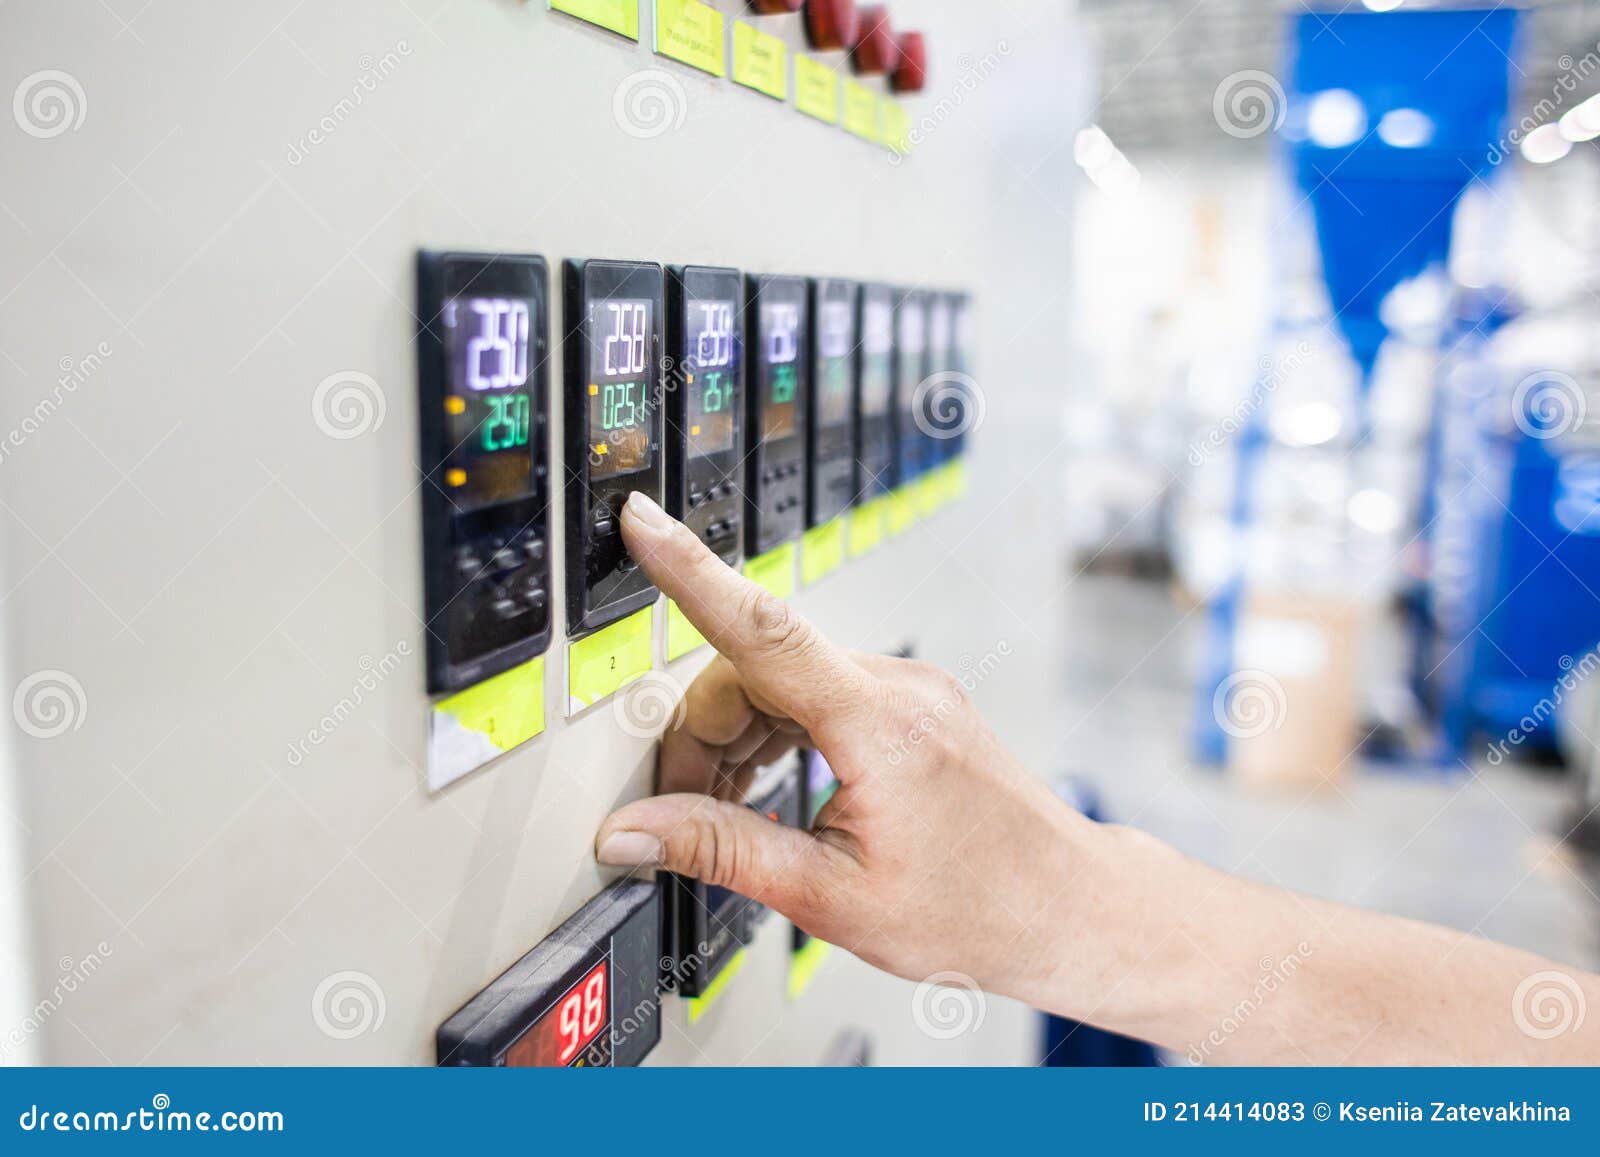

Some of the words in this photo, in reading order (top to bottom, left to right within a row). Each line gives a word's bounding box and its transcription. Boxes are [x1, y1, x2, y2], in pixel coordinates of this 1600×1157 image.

[604, 303, 645, 376] 258
[483, 394, 528, 450] 250
[610, 656, 616, 670] 2
[560, 971, 604, 1060] 98
